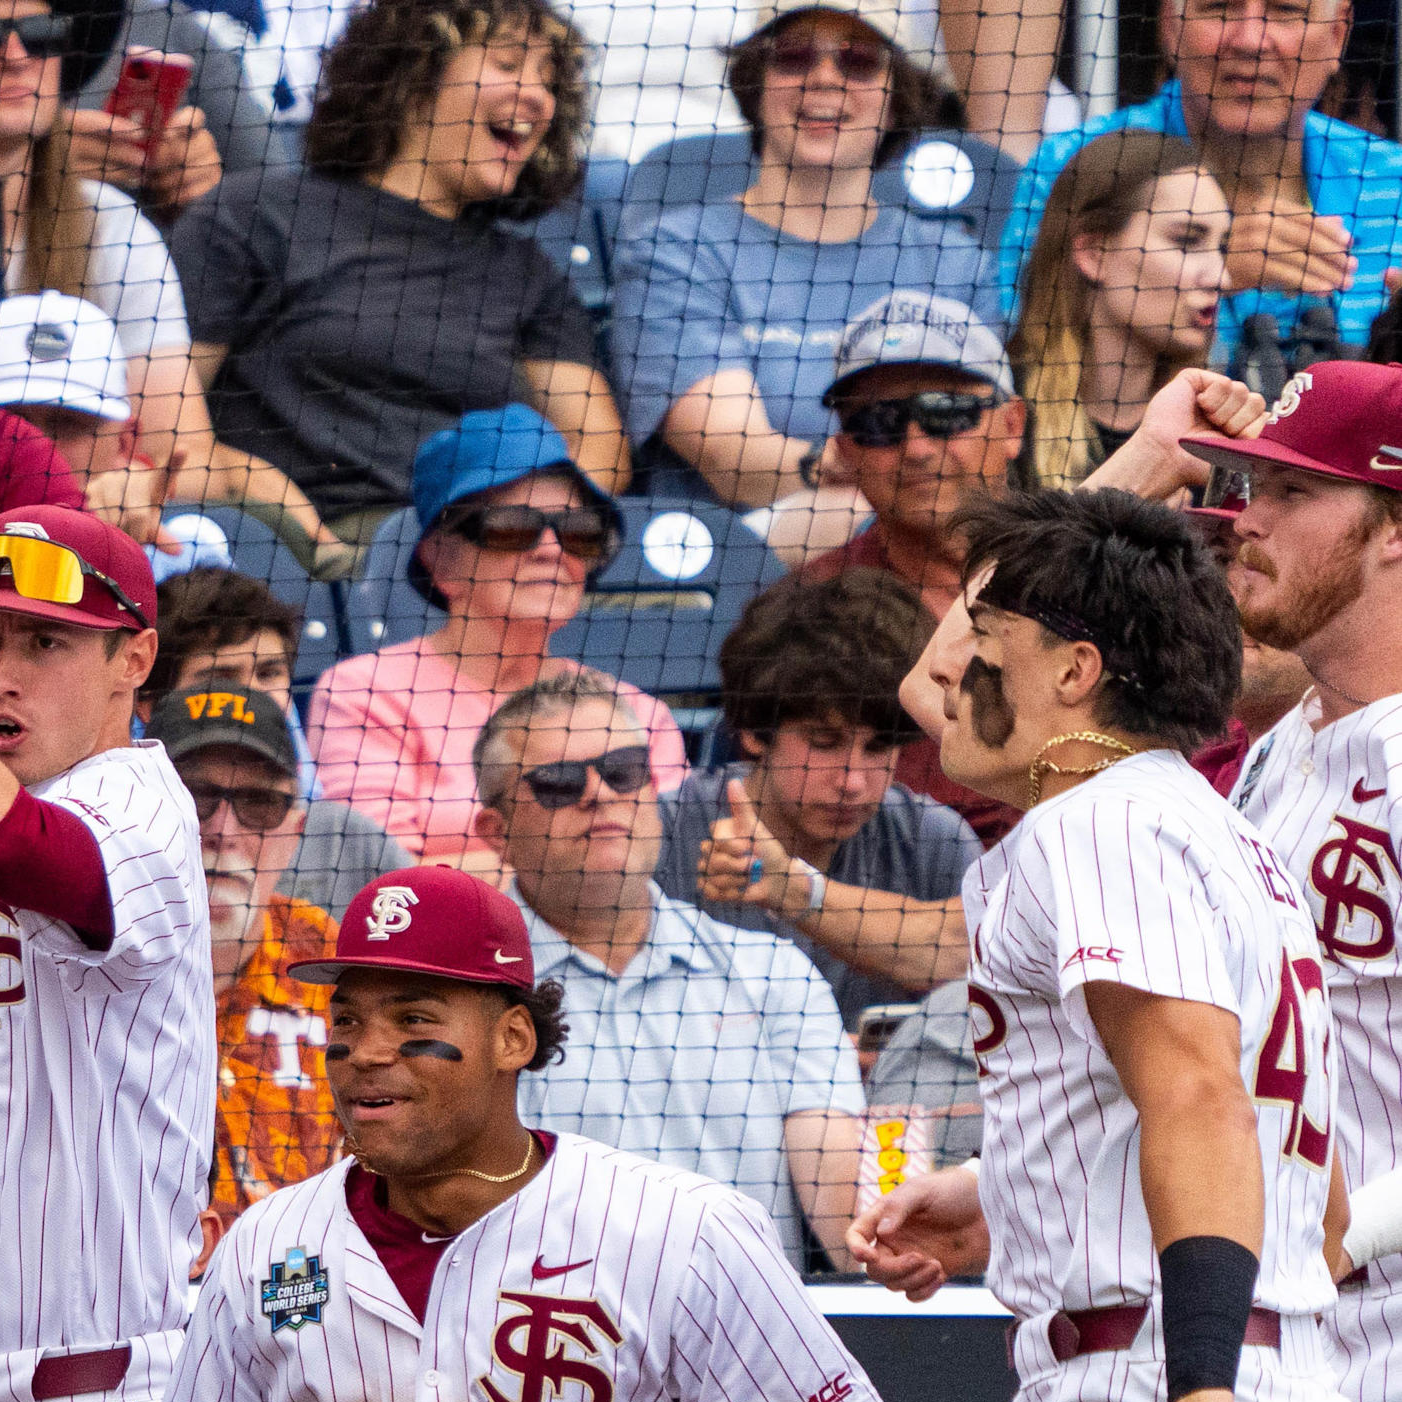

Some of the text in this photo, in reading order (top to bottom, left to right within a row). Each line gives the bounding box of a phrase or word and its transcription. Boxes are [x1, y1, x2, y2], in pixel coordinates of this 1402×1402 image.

[184, 691, 257, 725] VFL
[1060, 946, 1126, 973] ACC
[263, 1290, 327, 1313] WORLD SERIES
[277, 1281, 316, 1299] COLLEGE
